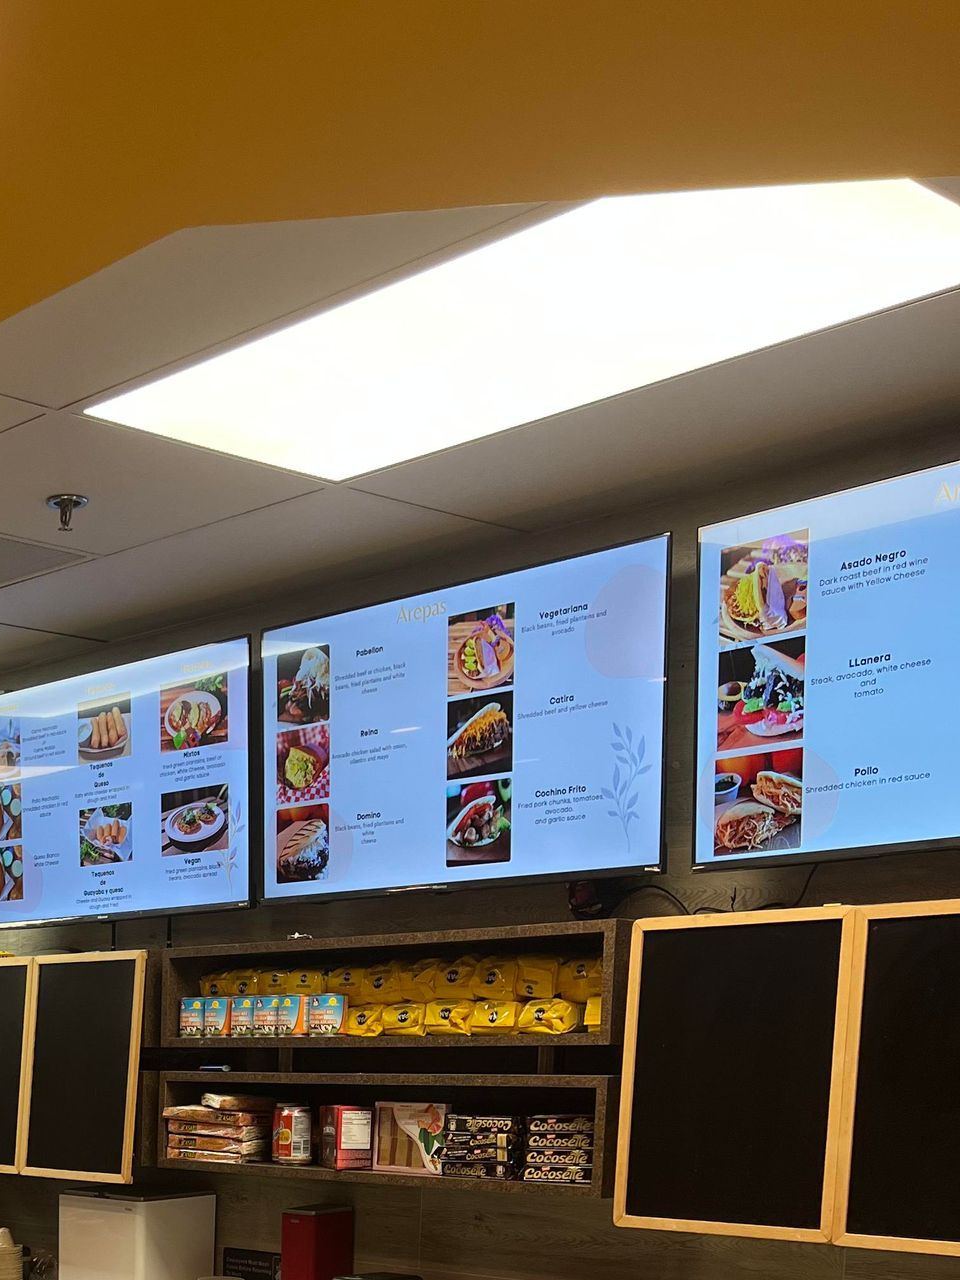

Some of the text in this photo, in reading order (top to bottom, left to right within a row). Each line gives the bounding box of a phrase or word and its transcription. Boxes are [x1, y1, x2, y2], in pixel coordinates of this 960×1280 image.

[840, 550, 906, 571] Asado Negro
[819, 576, 838, 587] Dark
[840, 572, 861, 582] roast
[862, 568, 881, 577] beef
[892, 562, 906, 570] red
[909, 557, 928, 567] wine
[821, 568, 925, 596] sauce with Yellow Cheese
[397, 601, 447, 624] Arepas
[540, 604, 588, 620] Vegetariana
[849, 653, 891, 668] LLanera
[876, 664, 898, 674] white
[900, 658, 931, 670] cheese
[860, 678, 876, 687] and
[550, 695, 574, 704] Catira
[854, 688, 884, 698] tomato
[361, 729, 378, 737] Reina
[854, 766, 879, 776] Pollo
[806, 783, 844, 794] Shredded
[845, 778, 877, 789] chicken
[888, 774, 902, 783] red
[904, 772, 931, 781] sauce
[535, 785, 586, 797] Cochino Frito
[357, 812, 381, 820] Domino
[529, 1134, 590, 1147] Cocosette
[527, 1150, 587, 1164] Cocosette
[525, 1166, 584, 1180] Cocosette
